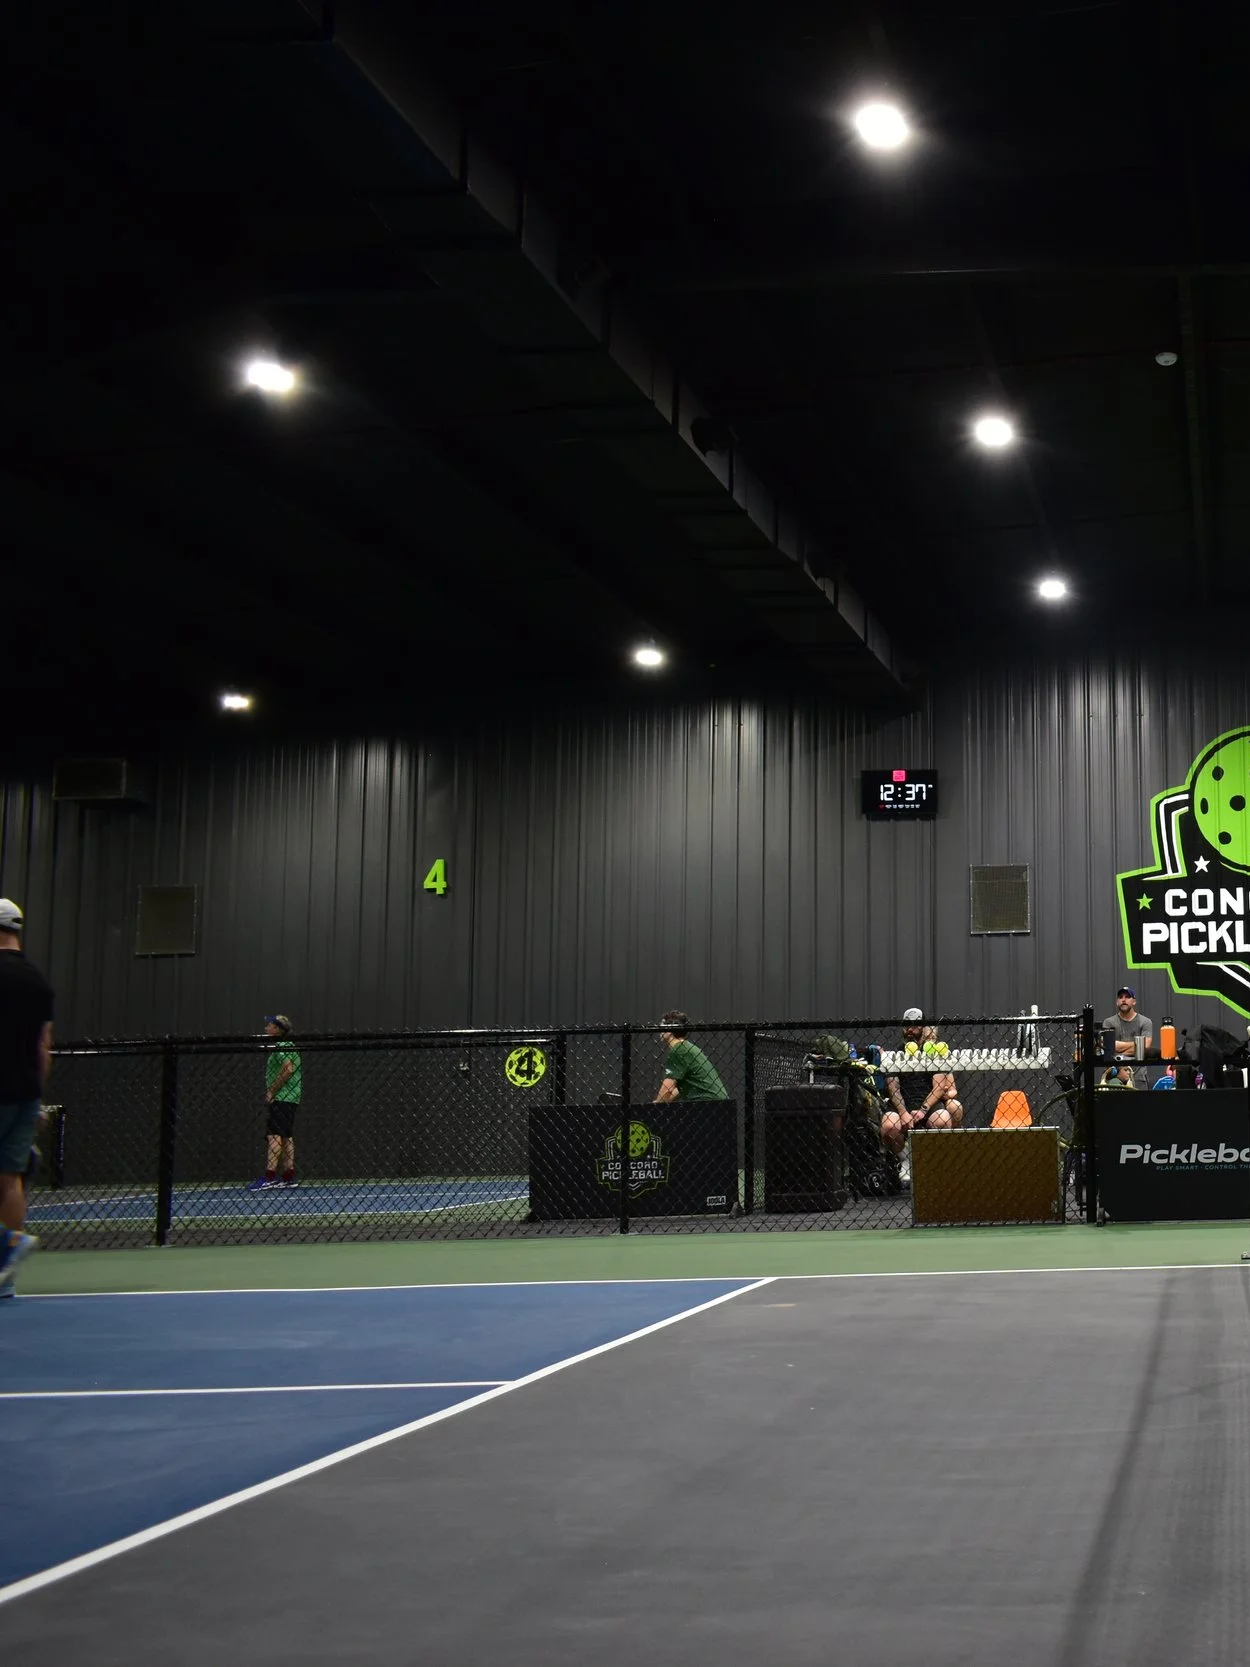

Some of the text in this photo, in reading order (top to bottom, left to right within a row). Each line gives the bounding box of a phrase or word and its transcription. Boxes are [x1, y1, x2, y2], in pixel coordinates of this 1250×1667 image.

[880, 784, 926, 801] 12:37
[423, 858, 447, 895] 4
[515, 1050, 536, 1081] 4
[608, 1161, 658, 1170] COCORD
